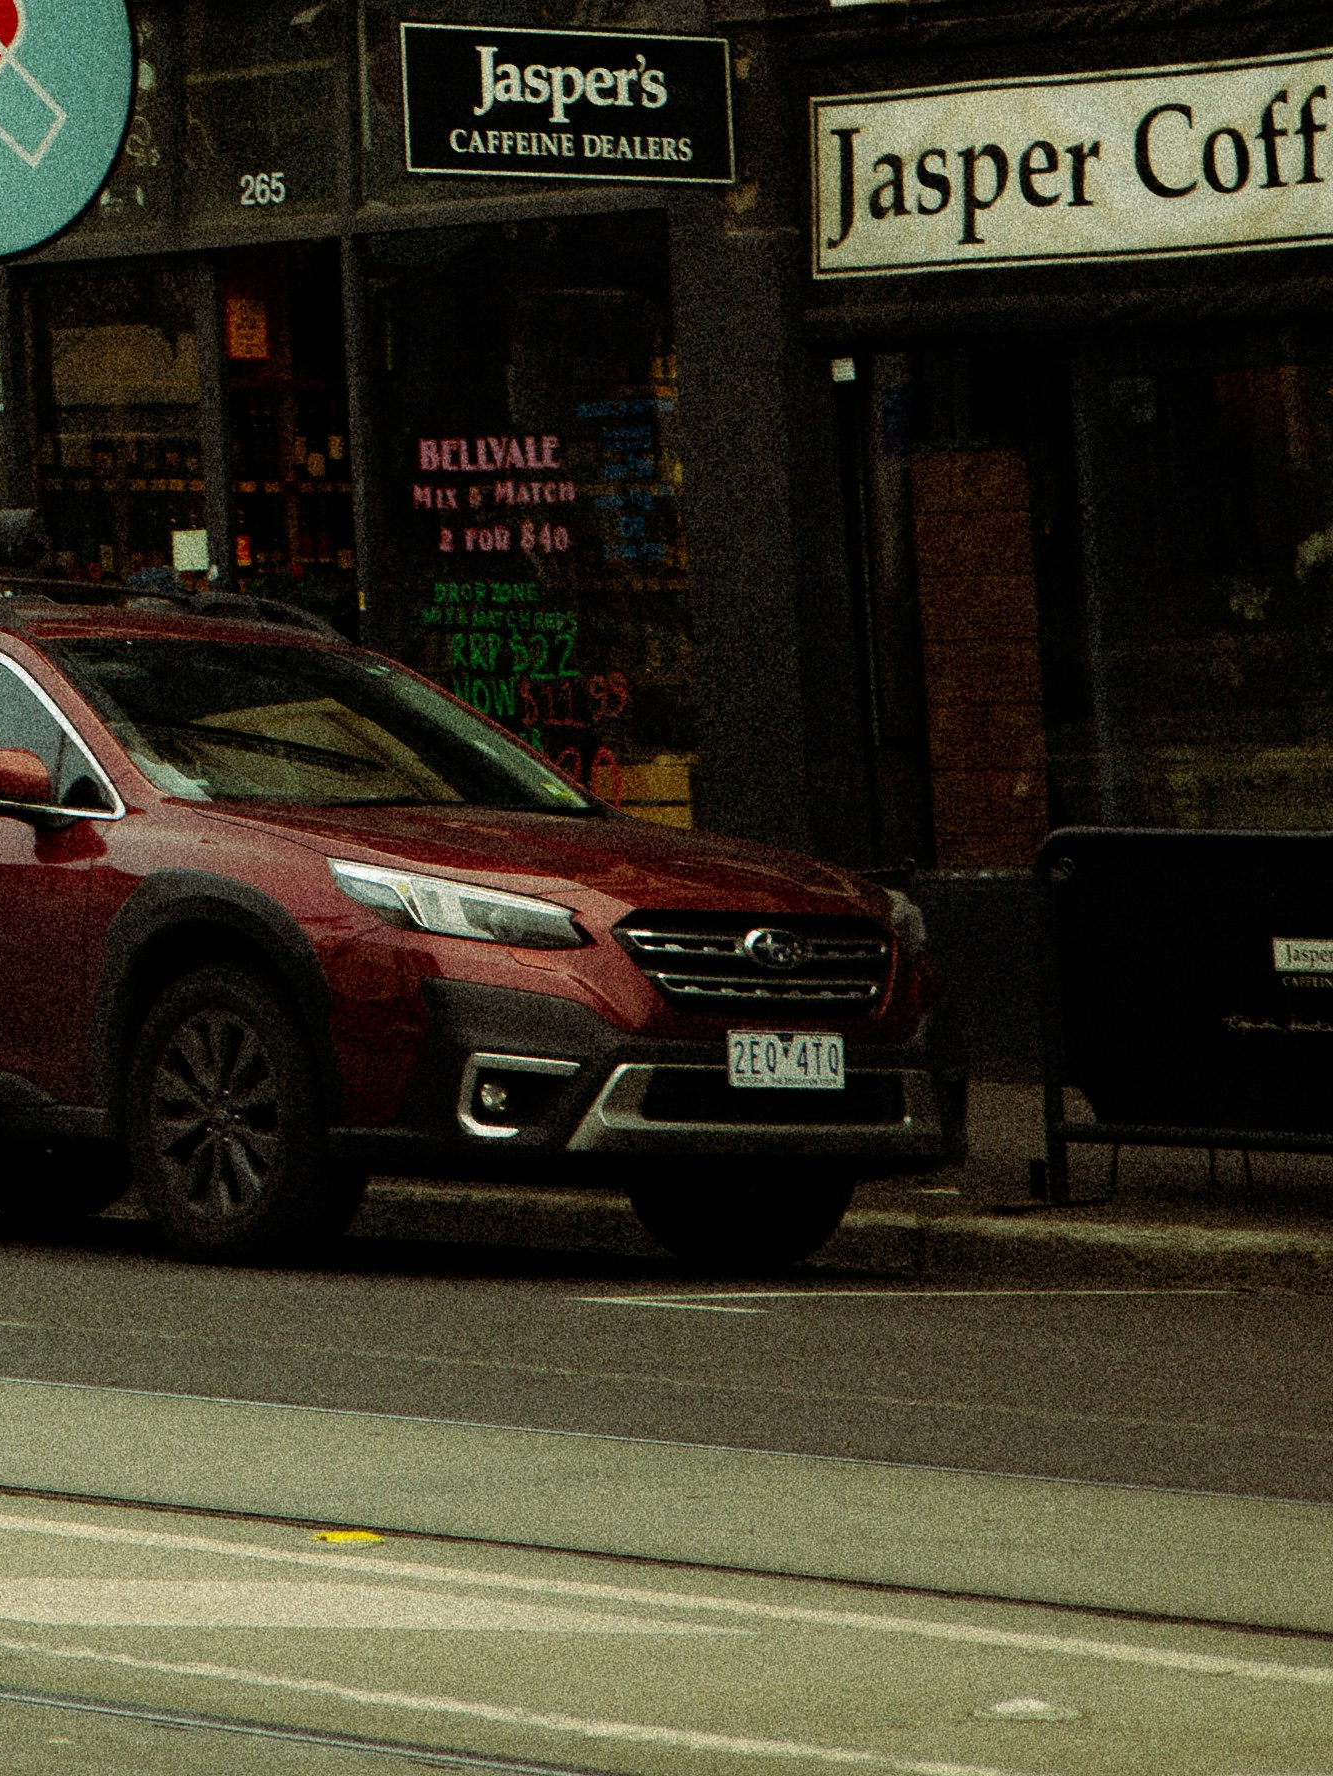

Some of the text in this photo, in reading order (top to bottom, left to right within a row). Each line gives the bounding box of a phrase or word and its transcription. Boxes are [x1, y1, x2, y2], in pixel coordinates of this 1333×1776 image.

[473, 46, 668, 122] Jasper's
[450, 129, 694, 162] CAFFEINE DEALERS
[239, 171, 286, 206] 265
[827, 128, 1101, 250] Jasper
[416, 435, 561, 472] BELLVALE
[452, 627, 581, 681] RRP $22
